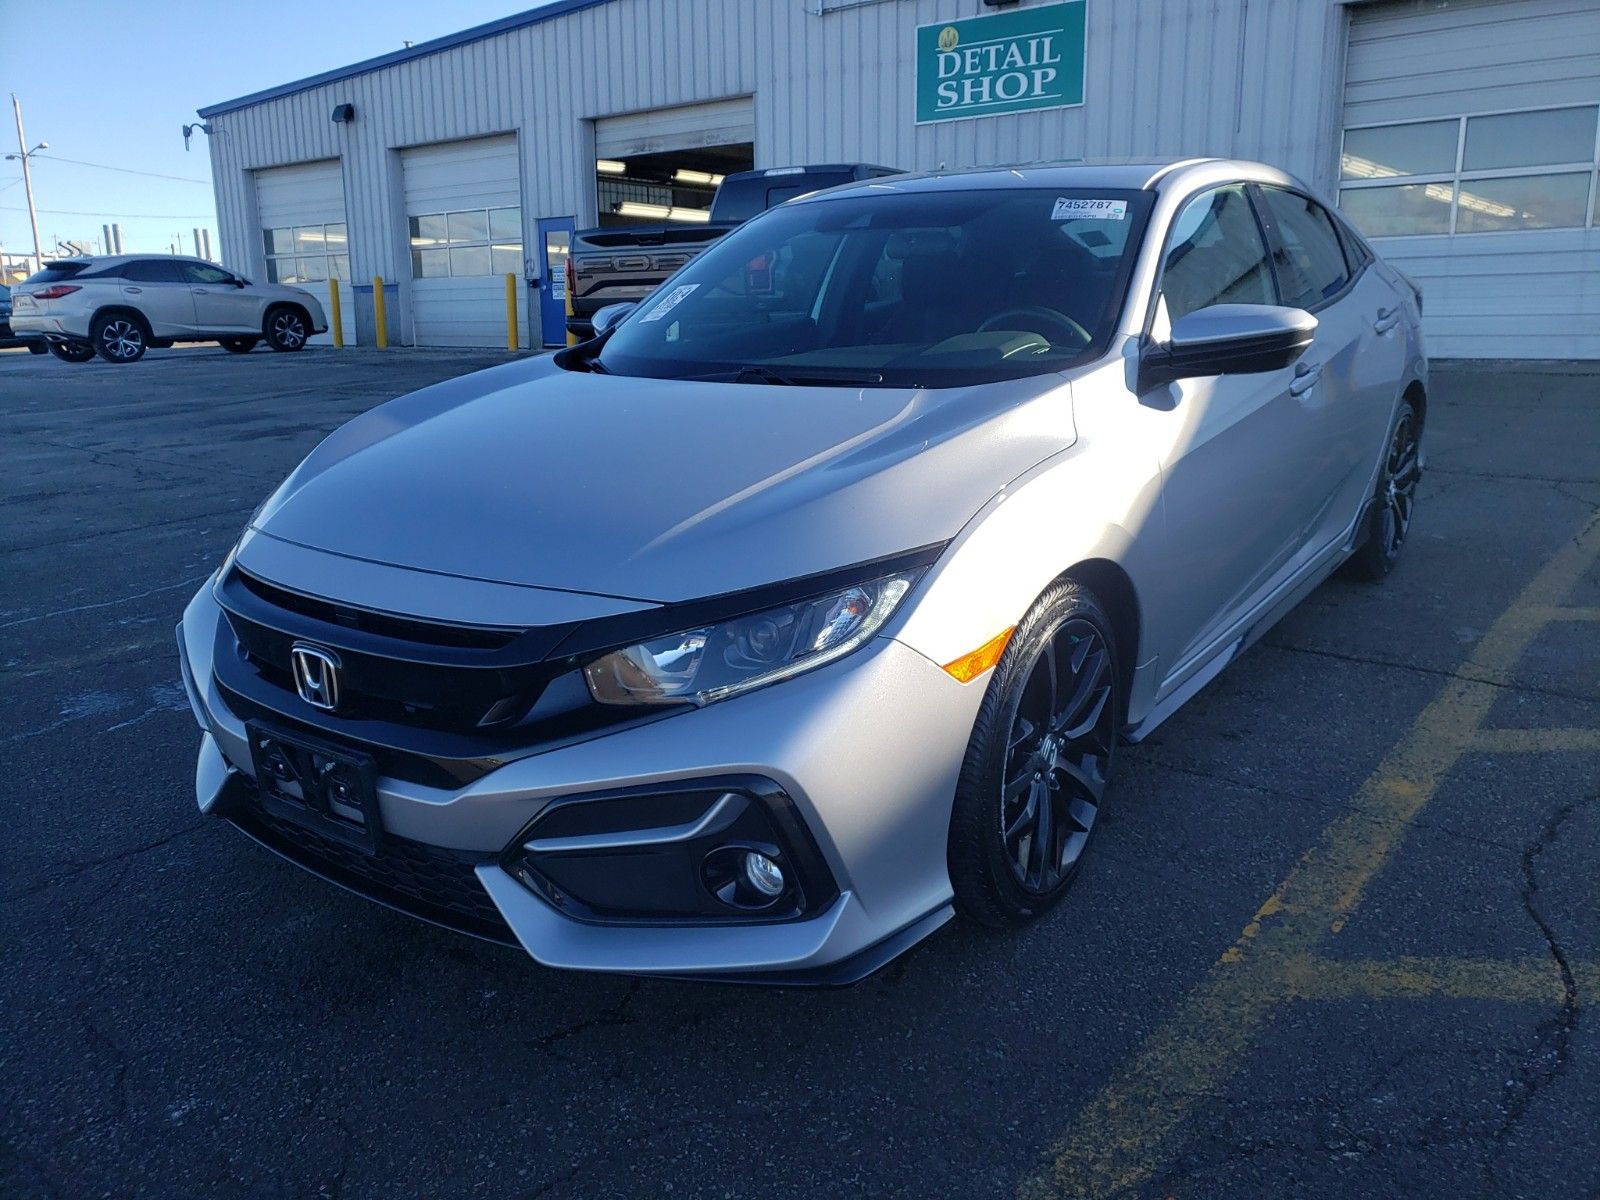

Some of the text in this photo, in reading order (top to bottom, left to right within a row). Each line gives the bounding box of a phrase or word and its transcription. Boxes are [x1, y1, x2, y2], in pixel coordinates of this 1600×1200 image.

[937, 36, 1061, 79] DETAIL
[937, 68, 1057, 108] SHOP
[1058, 201, 1113, 210] 7452787
